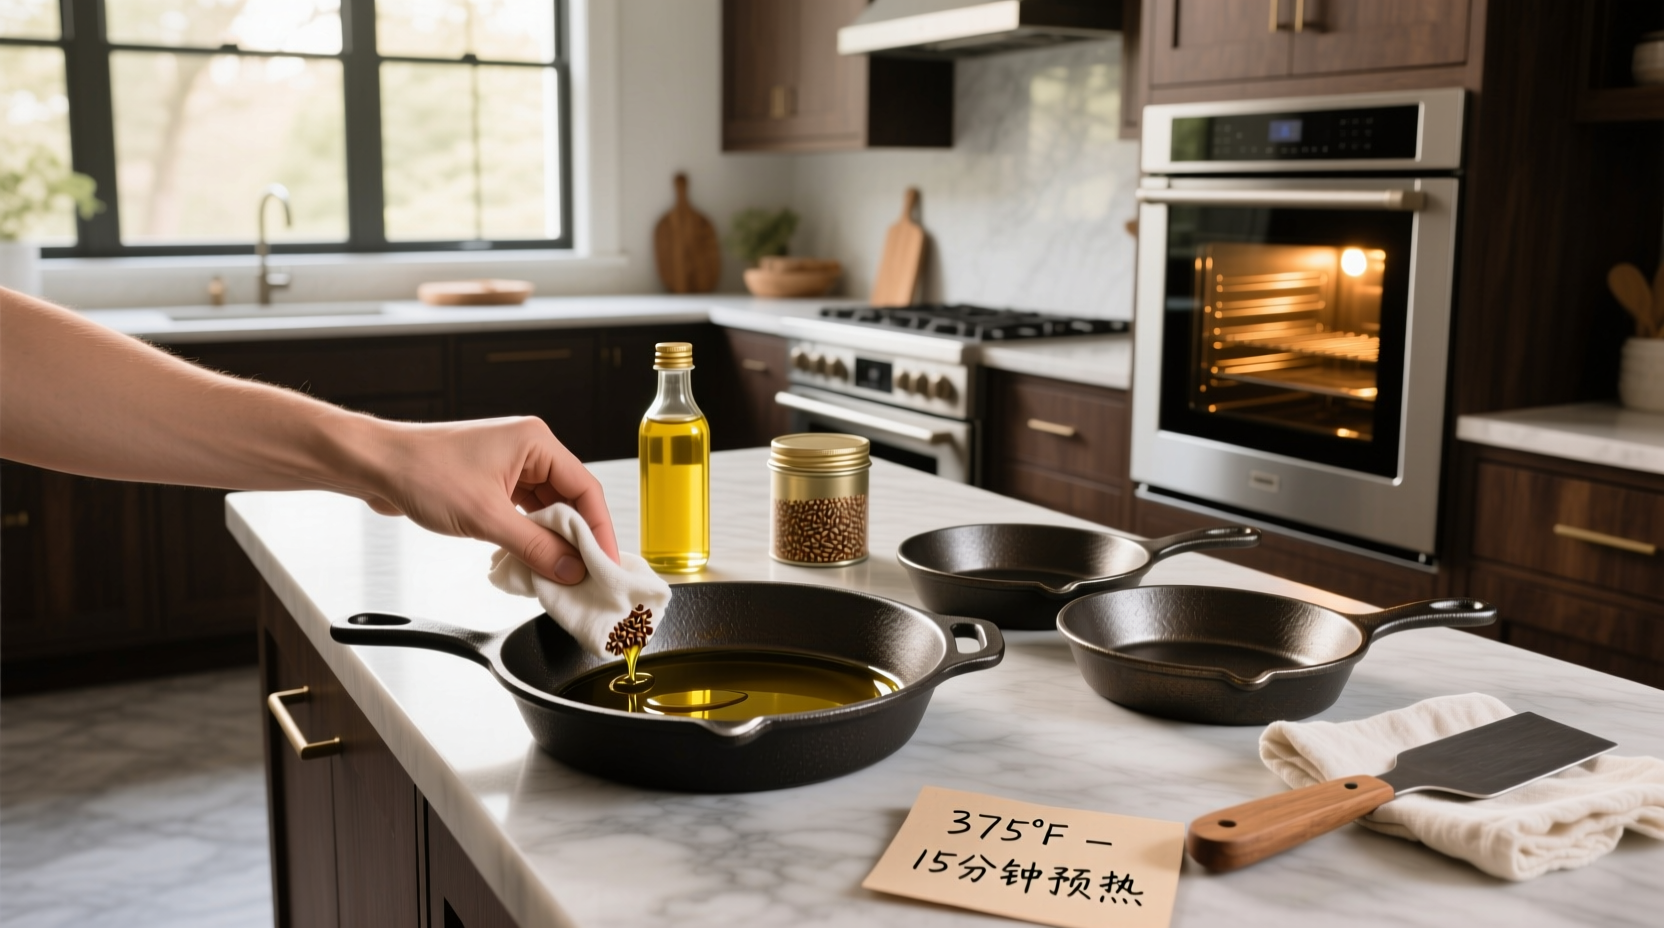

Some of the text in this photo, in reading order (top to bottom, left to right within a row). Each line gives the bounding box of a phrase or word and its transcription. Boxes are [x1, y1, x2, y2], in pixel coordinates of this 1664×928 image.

[947, 810, 1069, 845] 375°F
[912, 849, 1144, 907] 15分钟预热
